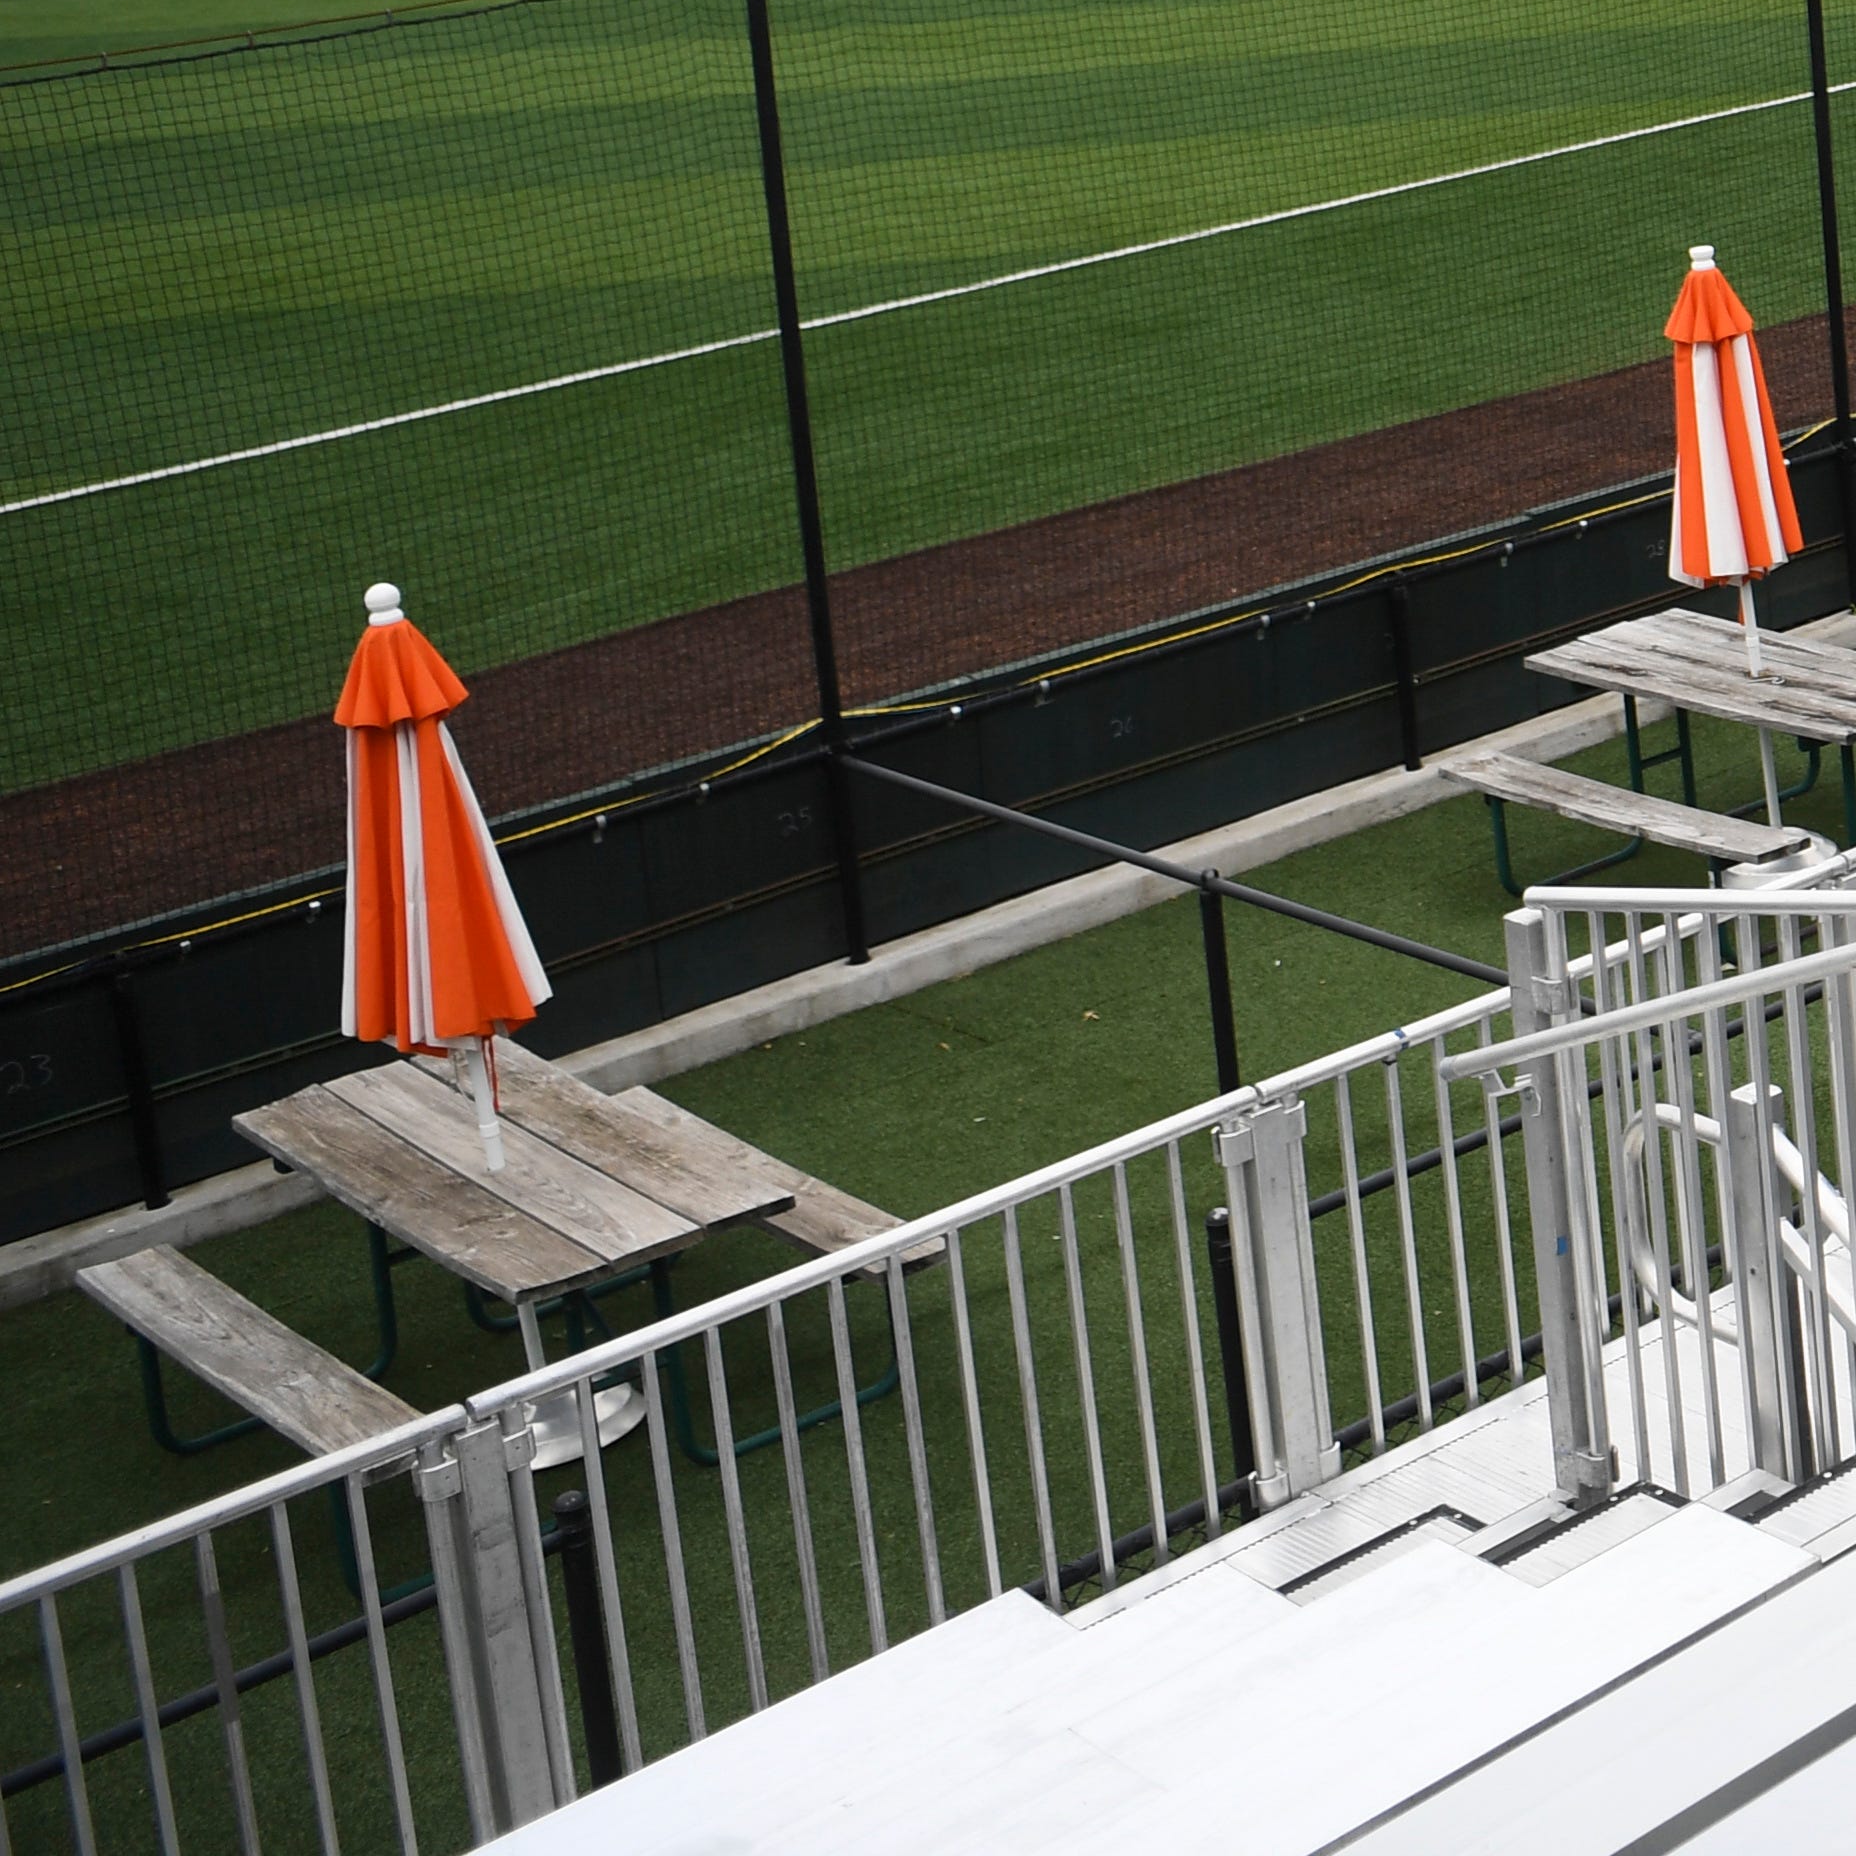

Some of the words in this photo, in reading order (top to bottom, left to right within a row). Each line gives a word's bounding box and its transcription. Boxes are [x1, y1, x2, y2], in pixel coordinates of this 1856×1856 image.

[1110, 714, 1136, 738] 26
[777, 807, 813, 837] 25
[0, 1054, 53, 1095] 23
